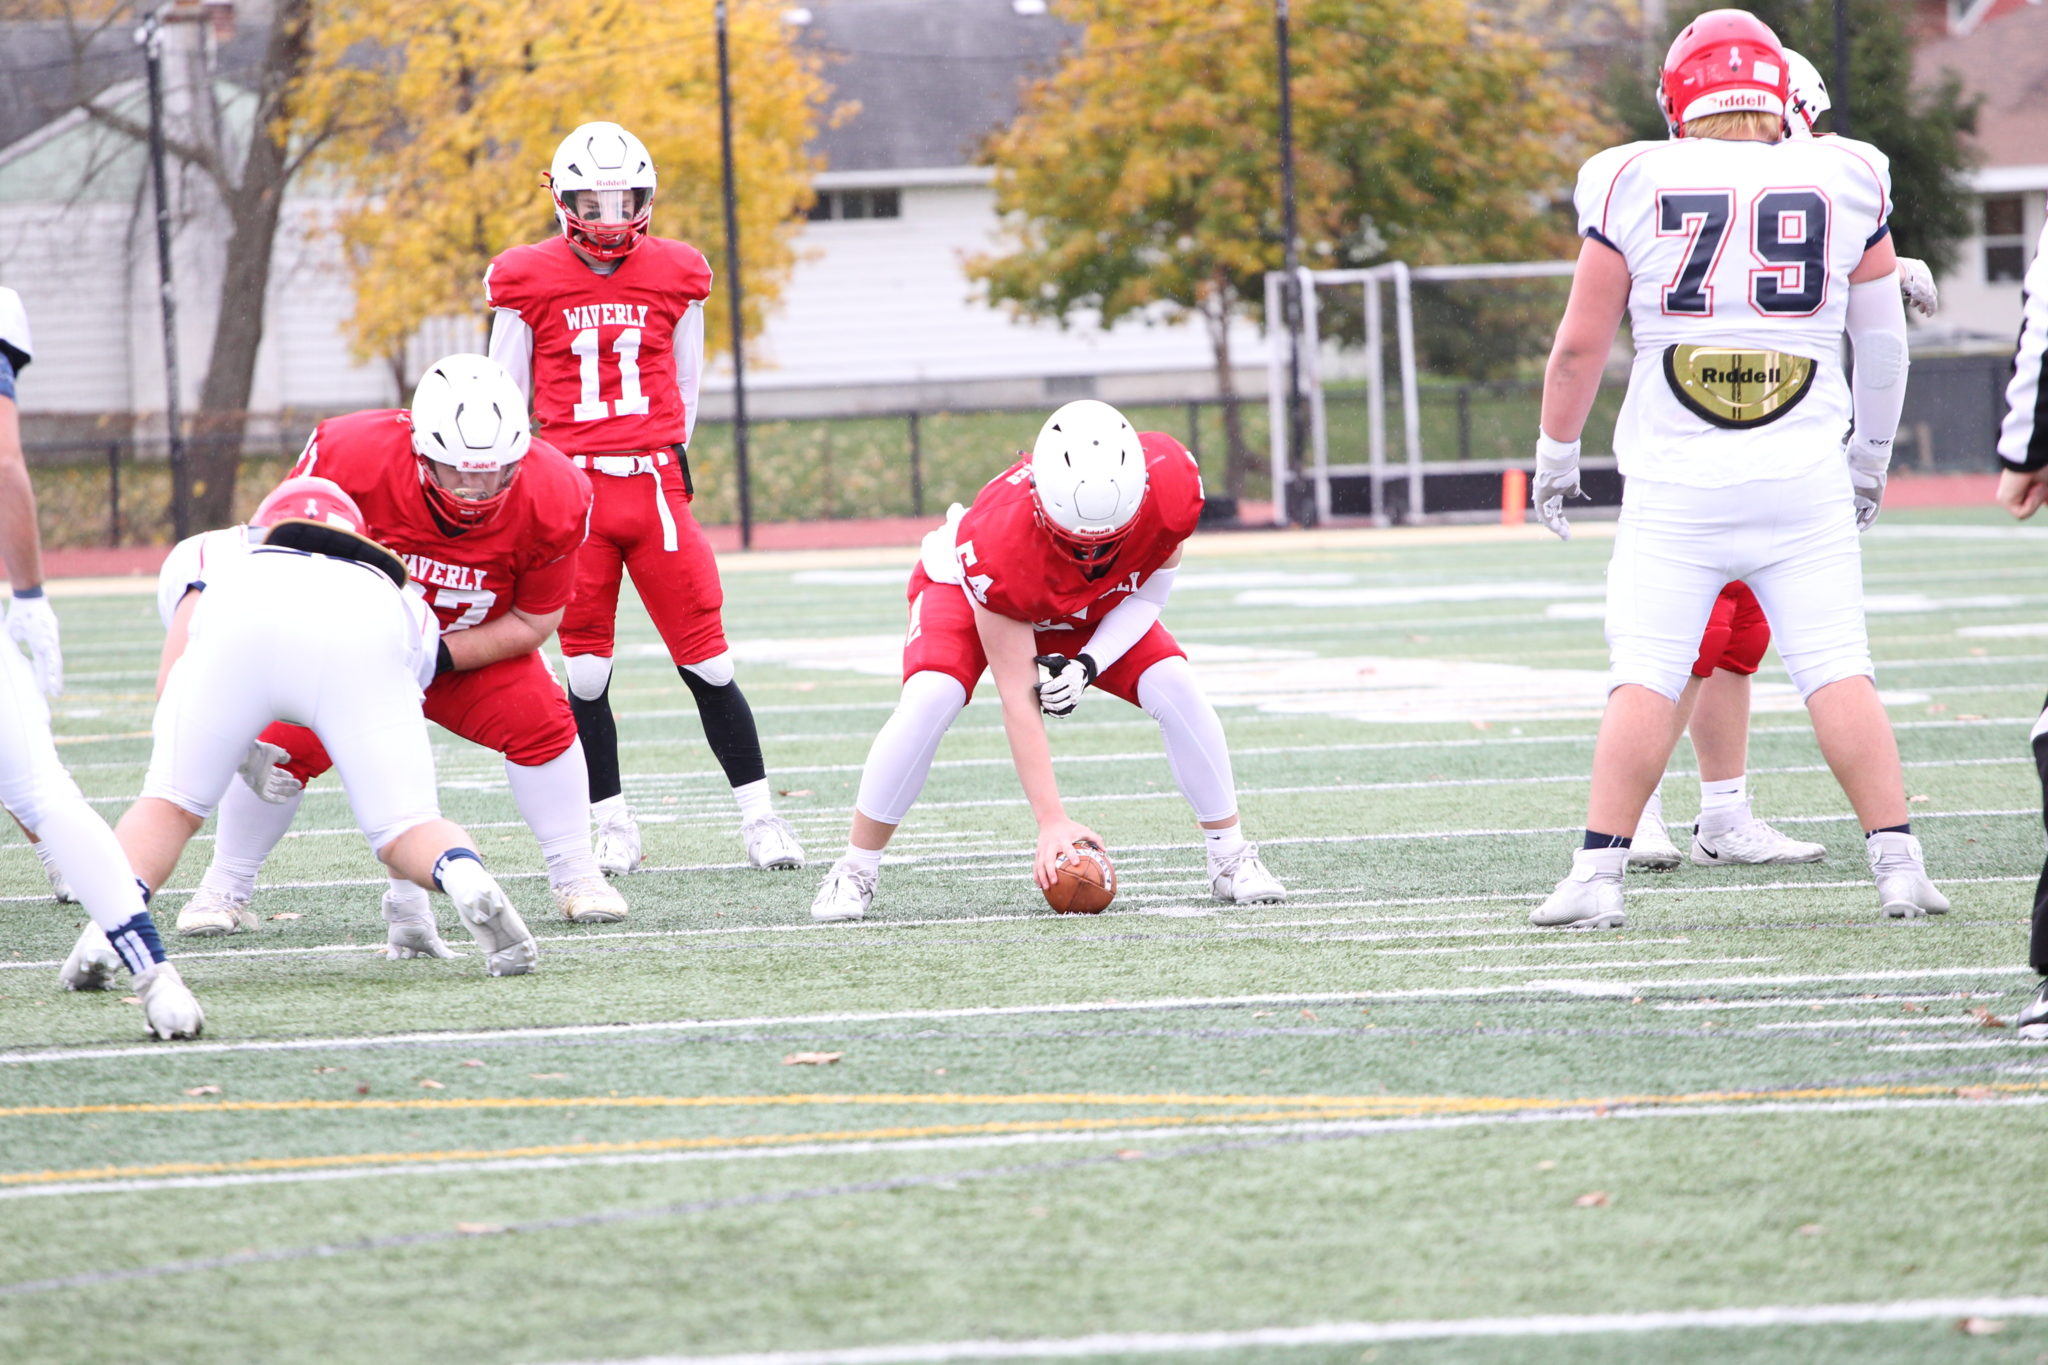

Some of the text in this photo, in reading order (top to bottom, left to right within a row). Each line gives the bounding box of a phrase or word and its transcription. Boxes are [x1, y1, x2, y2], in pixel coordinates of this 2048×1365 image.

[595, 179, 628, 187] Riddell
[1656, 186, 1832, 318] 79
[562, 303, 649, 328] WAVERLY
[570, 328, 650, 422] 11
[1702, 367, 1781, 383] Riddell
[396, 551, 488, 591] AVERLY
[407, 579, 498, 635] 7
